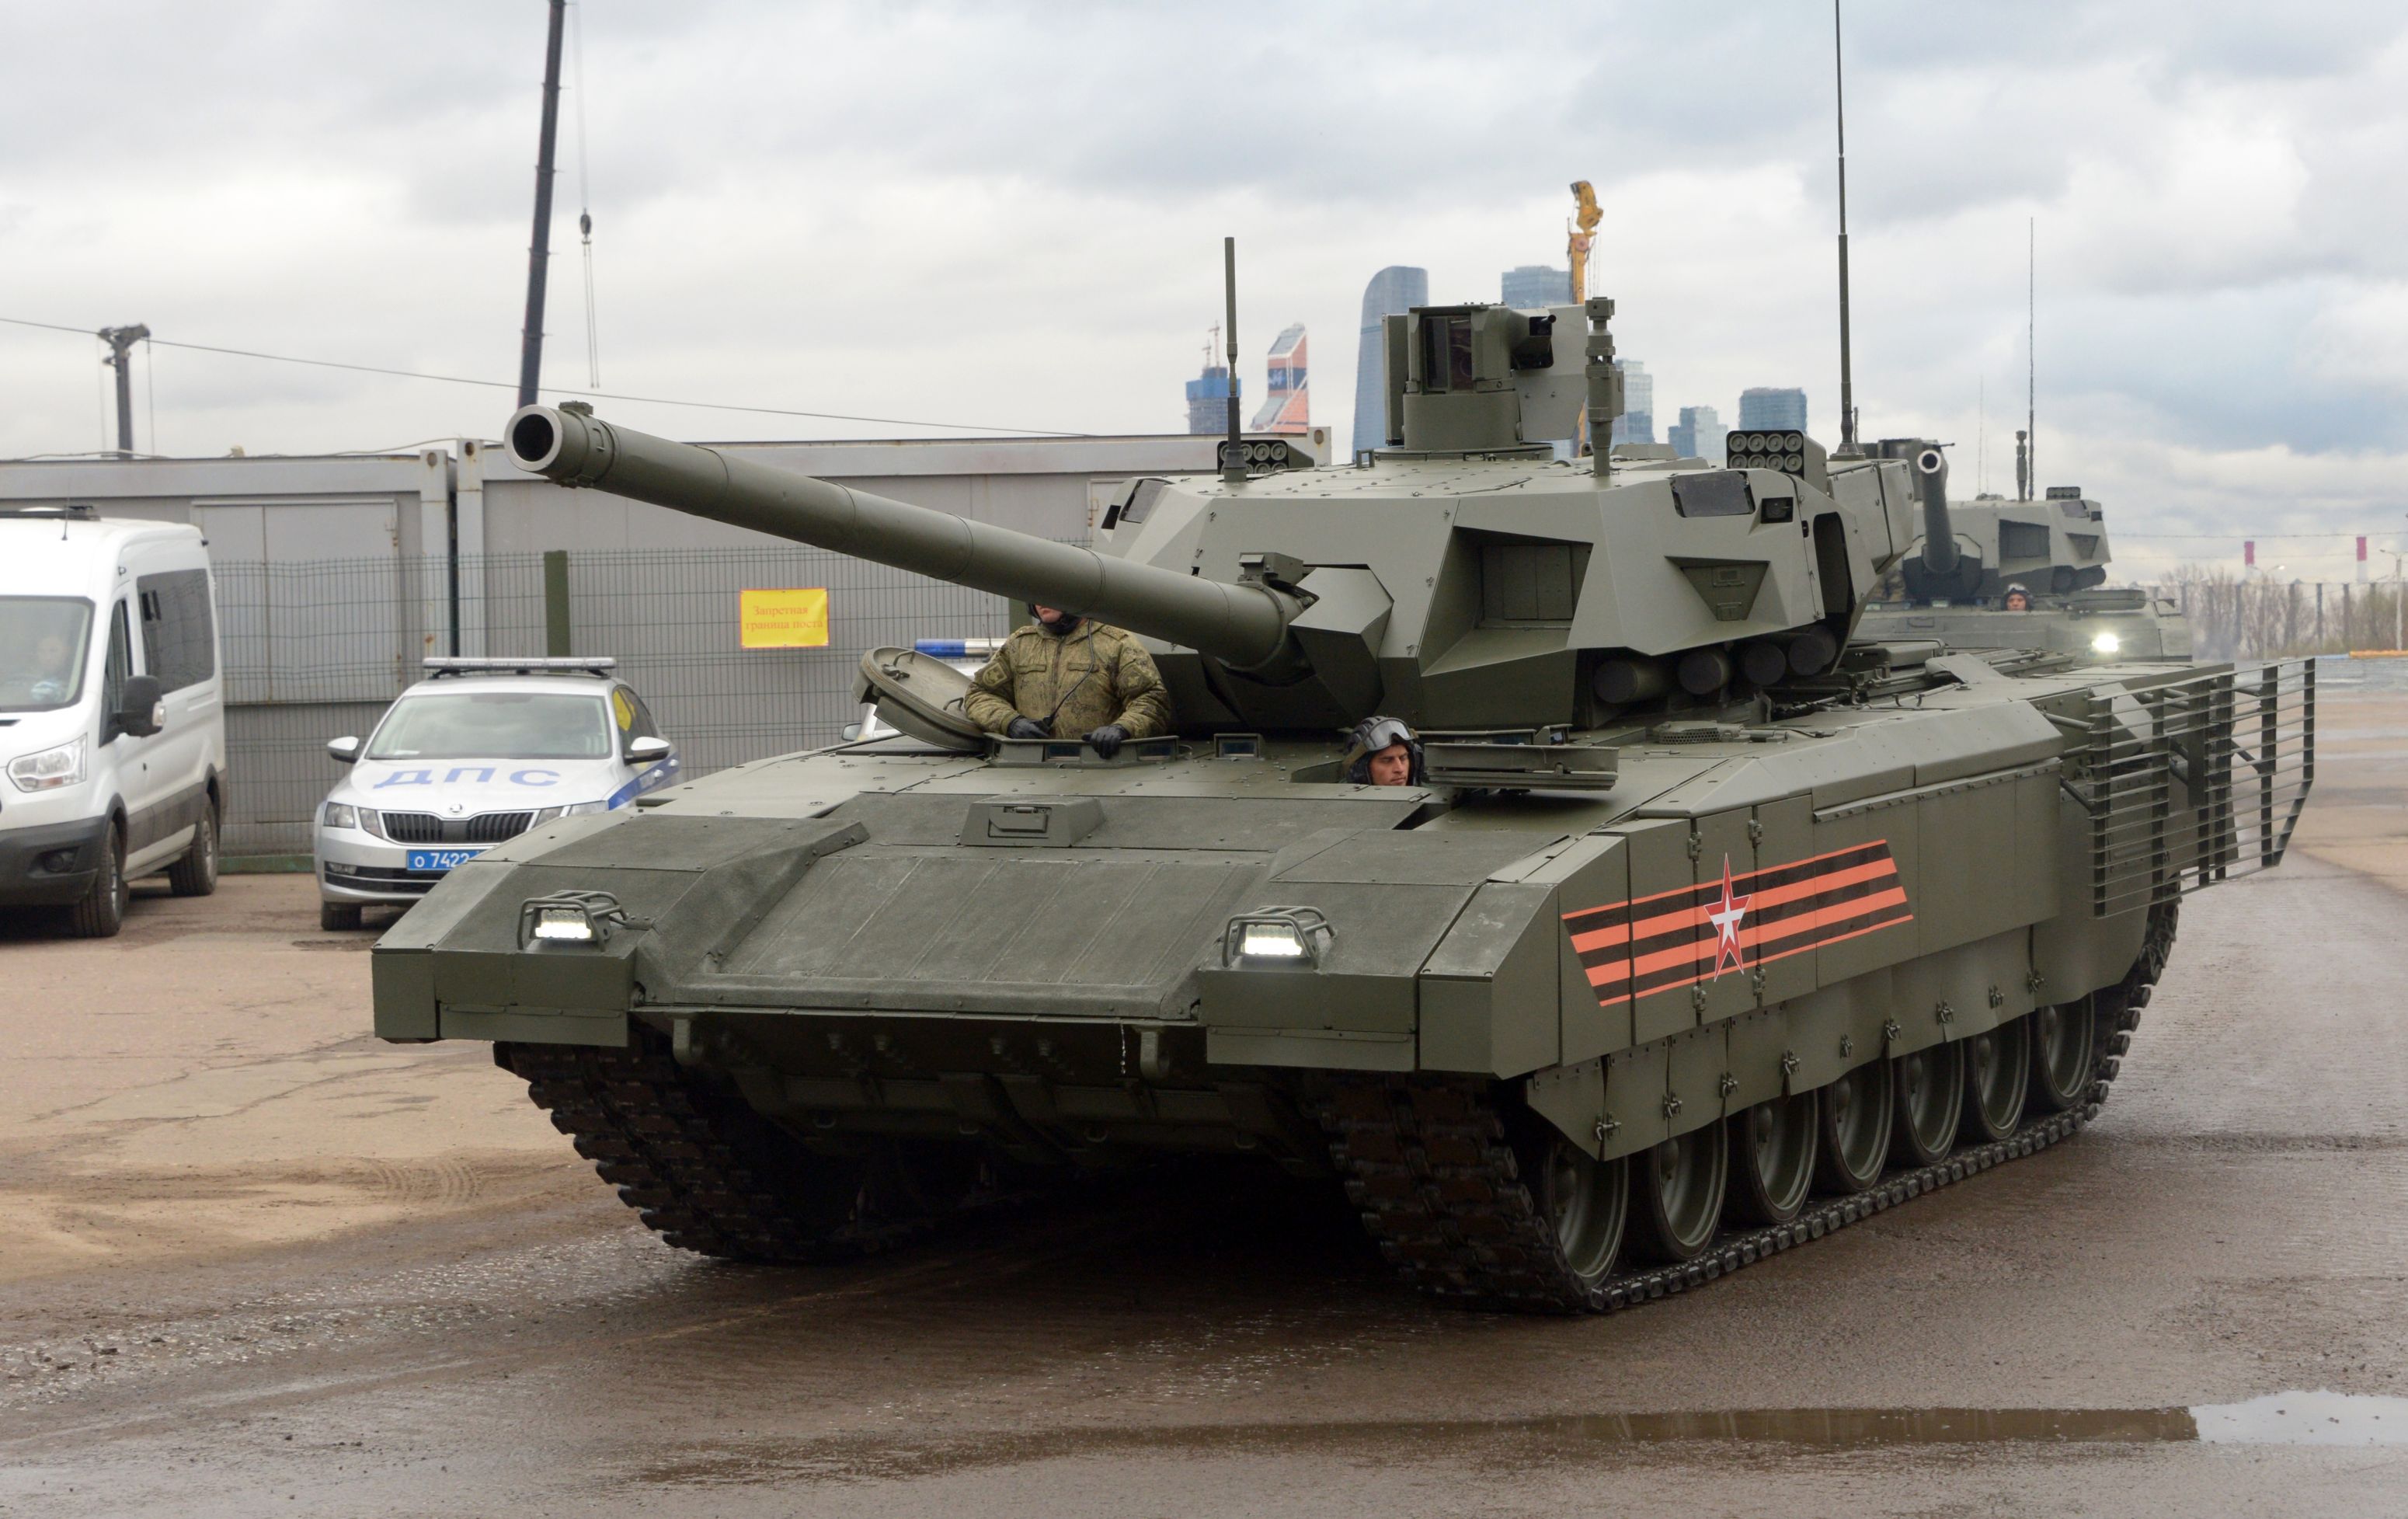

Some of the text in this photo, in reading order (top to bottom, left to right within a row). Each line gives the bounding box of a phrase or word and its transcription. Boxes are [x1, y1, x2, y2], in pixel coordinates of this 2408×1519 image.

[753, 605, 808, 617] Запретная
[746, 620, 823, 632] граница поста
[374, 768, 560, 789] ДПС
